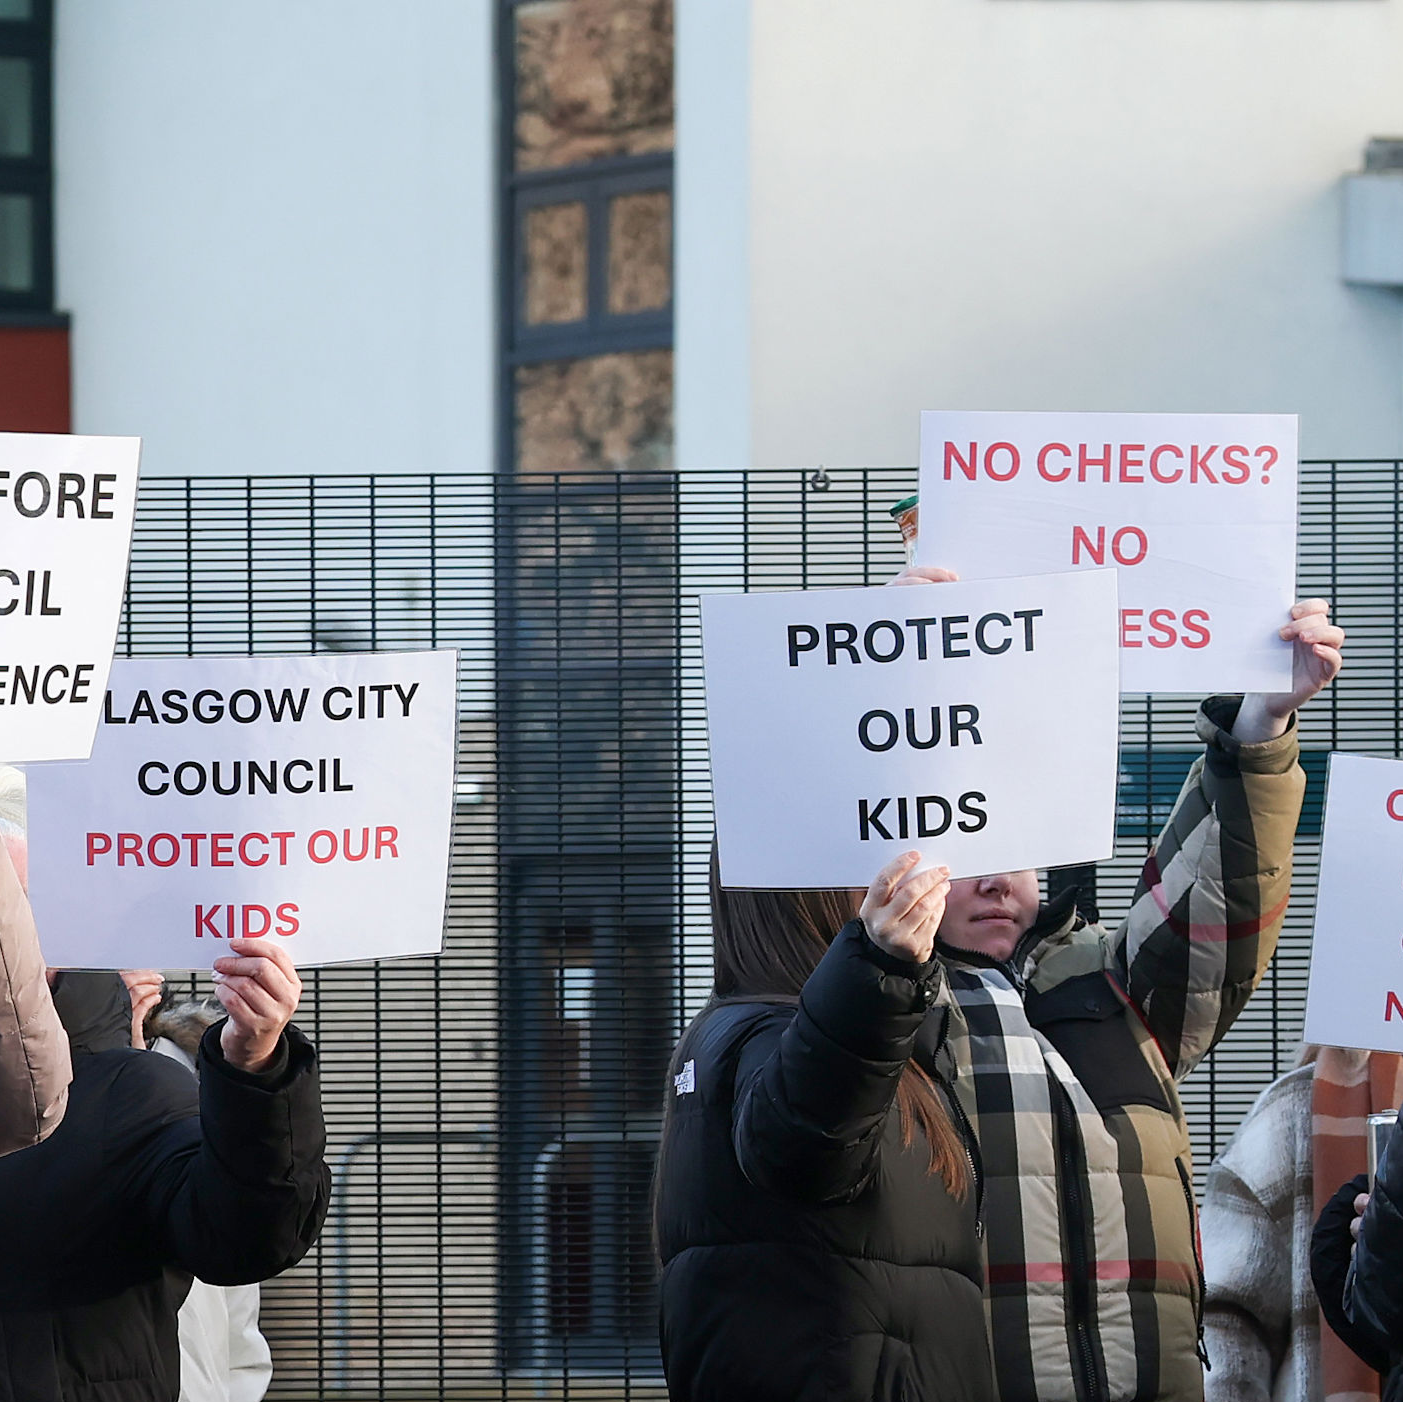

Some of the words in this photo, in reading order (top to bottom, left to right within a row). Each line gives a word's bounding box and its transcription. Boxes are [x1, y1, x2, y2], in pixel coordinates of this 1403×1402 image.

[944, 442, 1020, 481] NO
[1038, 443, 1278, 484] CHECKS?
[1073, 526, 1147, 565] NO
[788, 609, 1042, 666] PROTECT
[103, 688, 309, 724] LASGOW
[323, 683, 419, 720] CITY
[858, 705, 982, 752] OUR
[138, 759, 353, 795] COUNCIL
[859, 792, 987, 840] KIDS
[87, 828, 295, 867] PROTECT
[308, 826, 398, 863] OUR
[196, 903, 299, 938] KIDS
